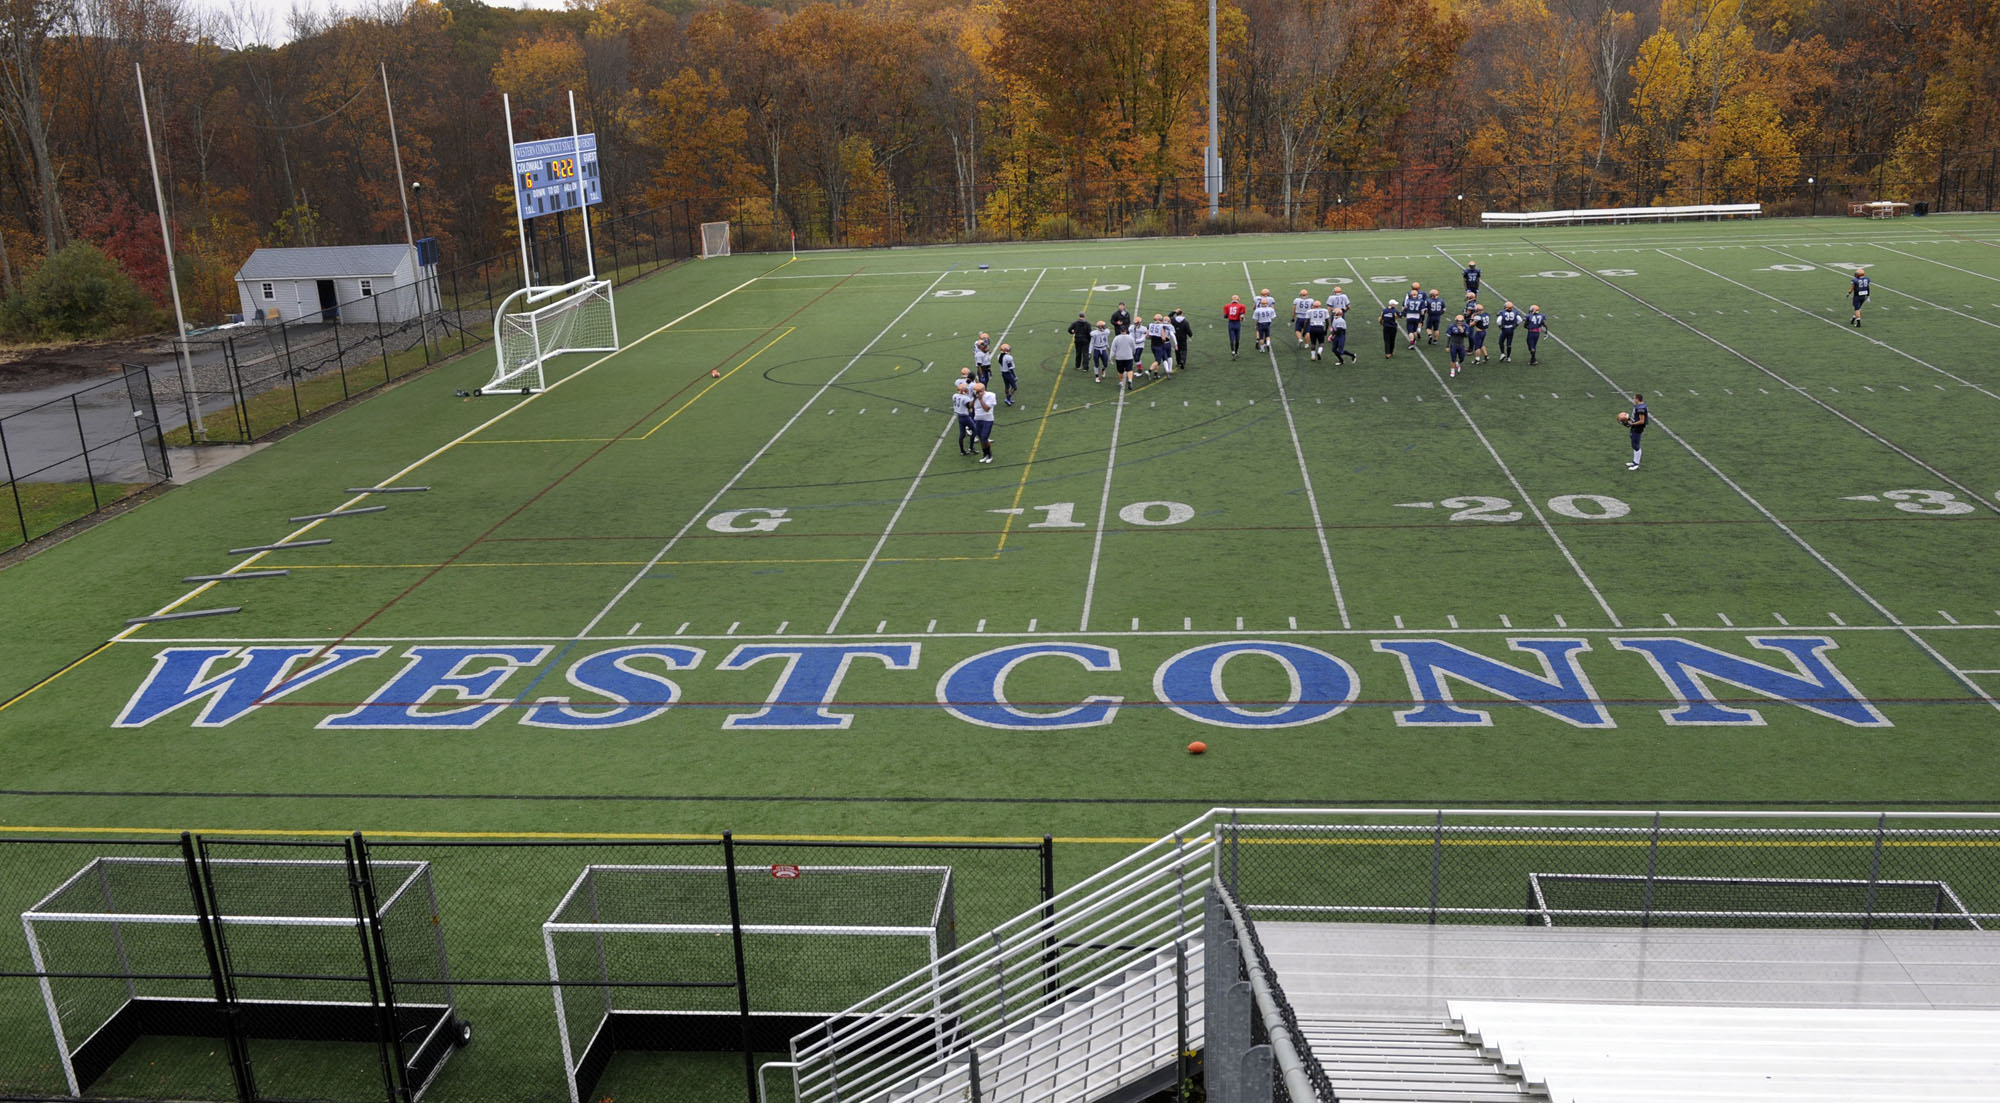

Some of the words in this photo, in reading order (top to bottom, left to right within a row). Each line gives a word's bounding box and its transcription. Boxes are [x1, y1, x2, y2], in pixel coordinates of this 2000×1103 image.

[517, 161, 543, 172] COLONIALS
[525, 172, 533, 188] 6
[1409, 300, 1422, 311] 57
[1430, 301, 1442, 312] 96
[1504, 311, 1516, 321] 39
[1531, 315, 1543, 325] 47
[705, 507, 793, 535] G
[110, 635, 1895, 732] WESTCONN
